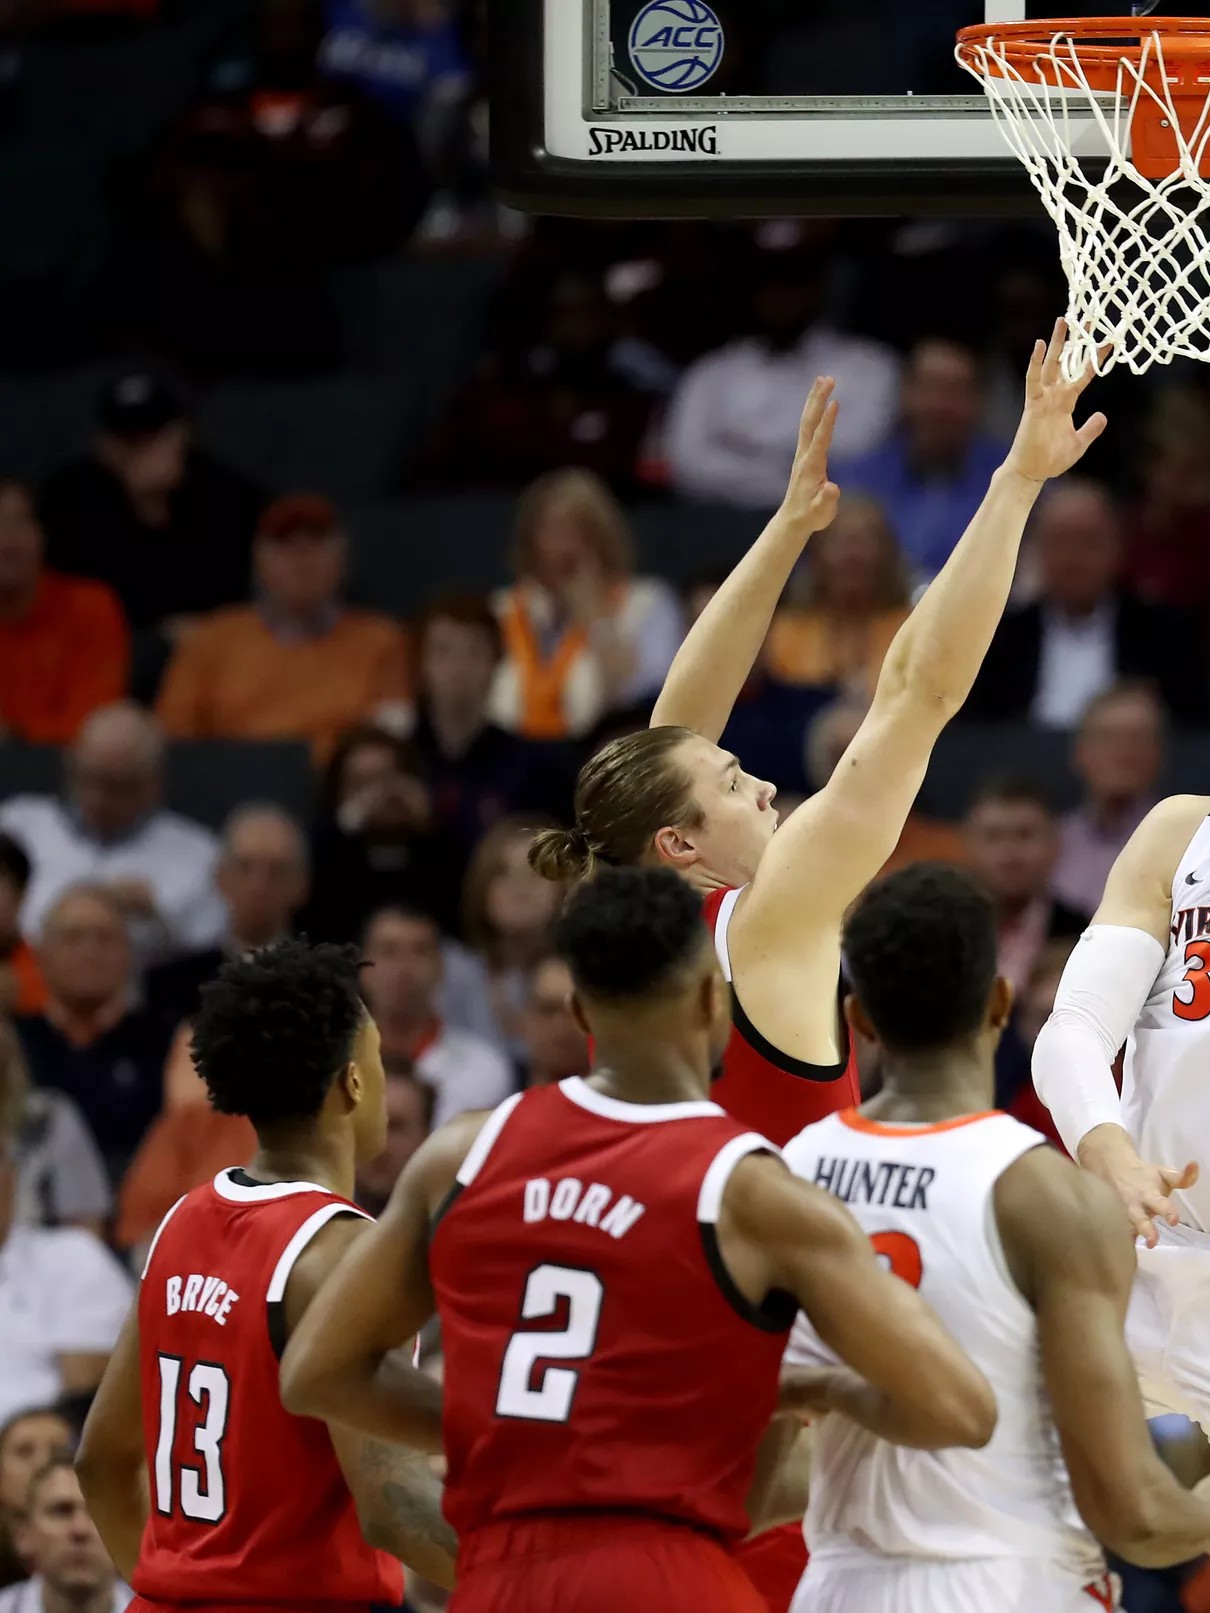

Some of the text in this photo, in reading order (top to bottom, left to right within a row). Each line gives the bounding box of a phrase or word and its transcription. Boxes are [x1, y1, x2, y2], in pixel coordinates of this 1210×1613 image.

[641, 26, 719, 47] ACC
[589, 126, 716, 155] SPALDING
[523, 1177, 645, 1239] DORN
[814, 1156, 935, 1210] HUNTER
[166, 1274, 240, 1326] BRYCE
[493, 1262, 604, 1423] 2
[150, 1352, 230, 1524] 13
